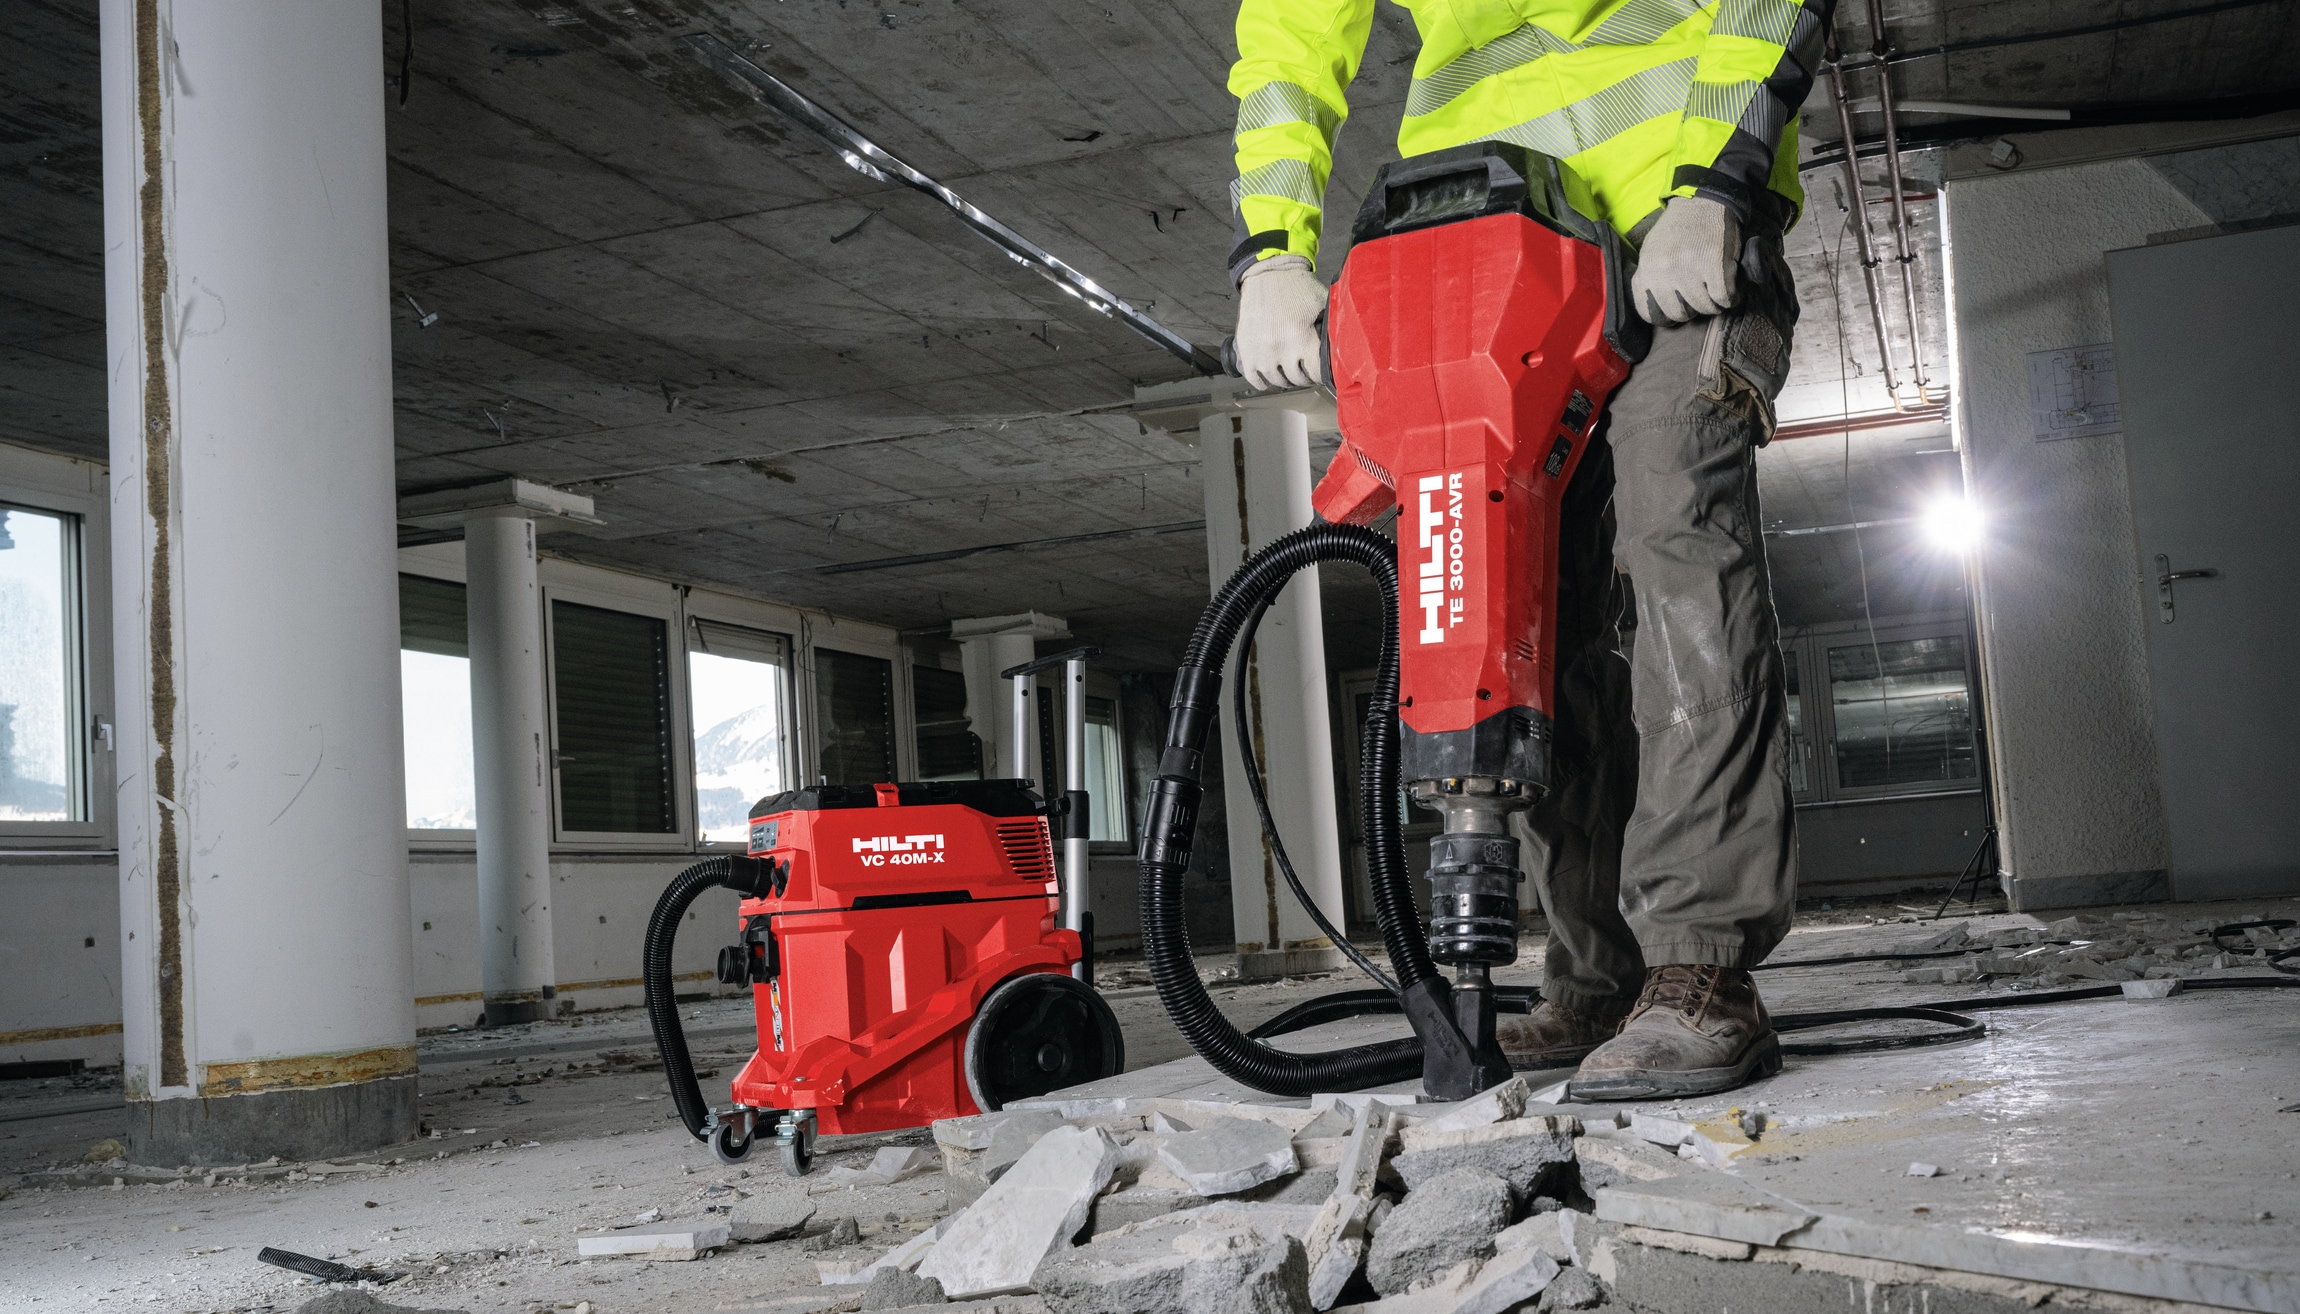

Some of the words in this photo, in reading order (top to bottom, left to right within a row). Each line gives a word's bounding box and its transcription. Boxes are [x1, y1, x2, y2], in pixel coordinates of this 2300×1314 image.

[1448, 471, 1464, 592] 3000-AVR
[1418, 474, 1445, 645] HILTI
[1449, 597, 1464, 629] TE
[852, 833, 945, 853] HILTI
[860, 854, 885, 867] VC
[889, 851, 945, 866] 40M-X
